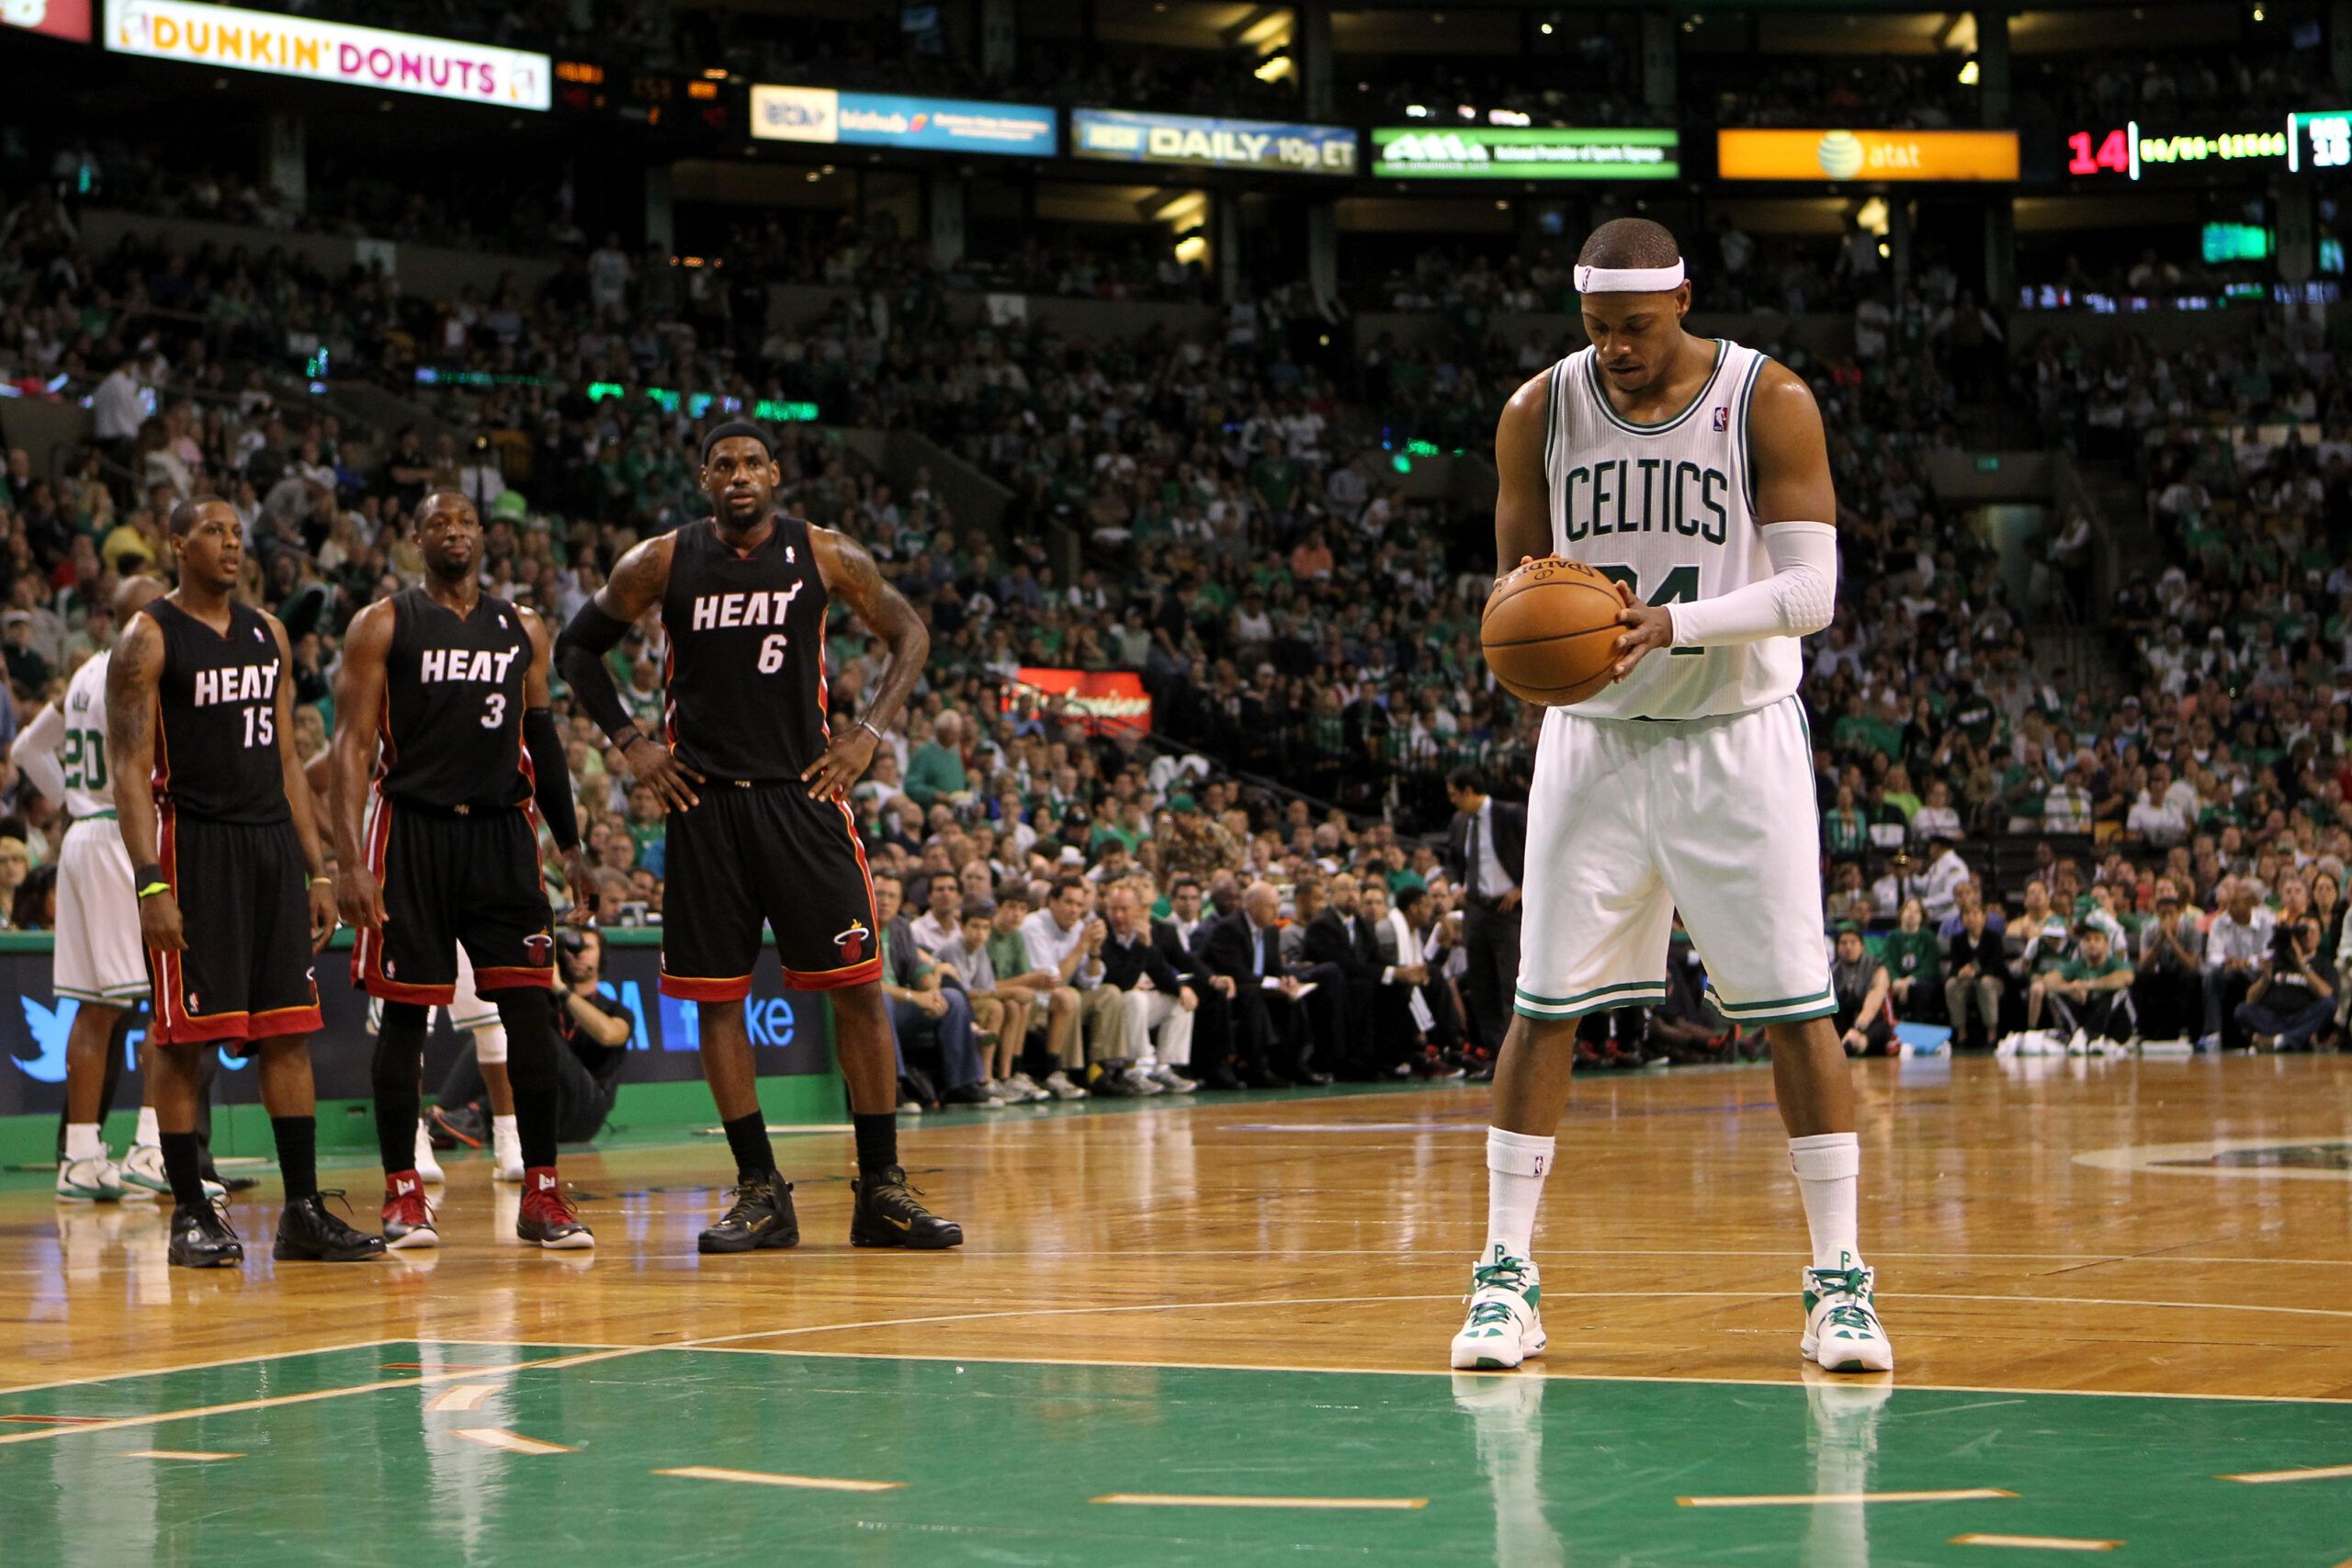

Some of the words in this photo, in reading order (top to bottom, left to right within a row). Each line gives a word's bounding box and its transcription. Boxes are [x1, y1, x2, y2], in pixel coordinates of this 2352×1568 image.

[153, 15, 331, 71] DUNKIN'
[339, 43, 495, 94] DONUTS
[1148, 128, 1271, 163] DAILY
[1323, 141, 1355, 167] ET
[2068, 130, 2129, 175] 14
[1565, 458, 1729, 546] CELTICS
[692, 577, 804, 632] HEAT
[1591, 562, 1705, 657] 4
[420, 644, 520, 684] HEAT
[757, 633, 788, 675] 6
[194, 657, 280, 708] HEAT
[243, 705, 274, 749] 15
[481, 693, 507, 729] 3
[64, 728, 108, 792] 20
